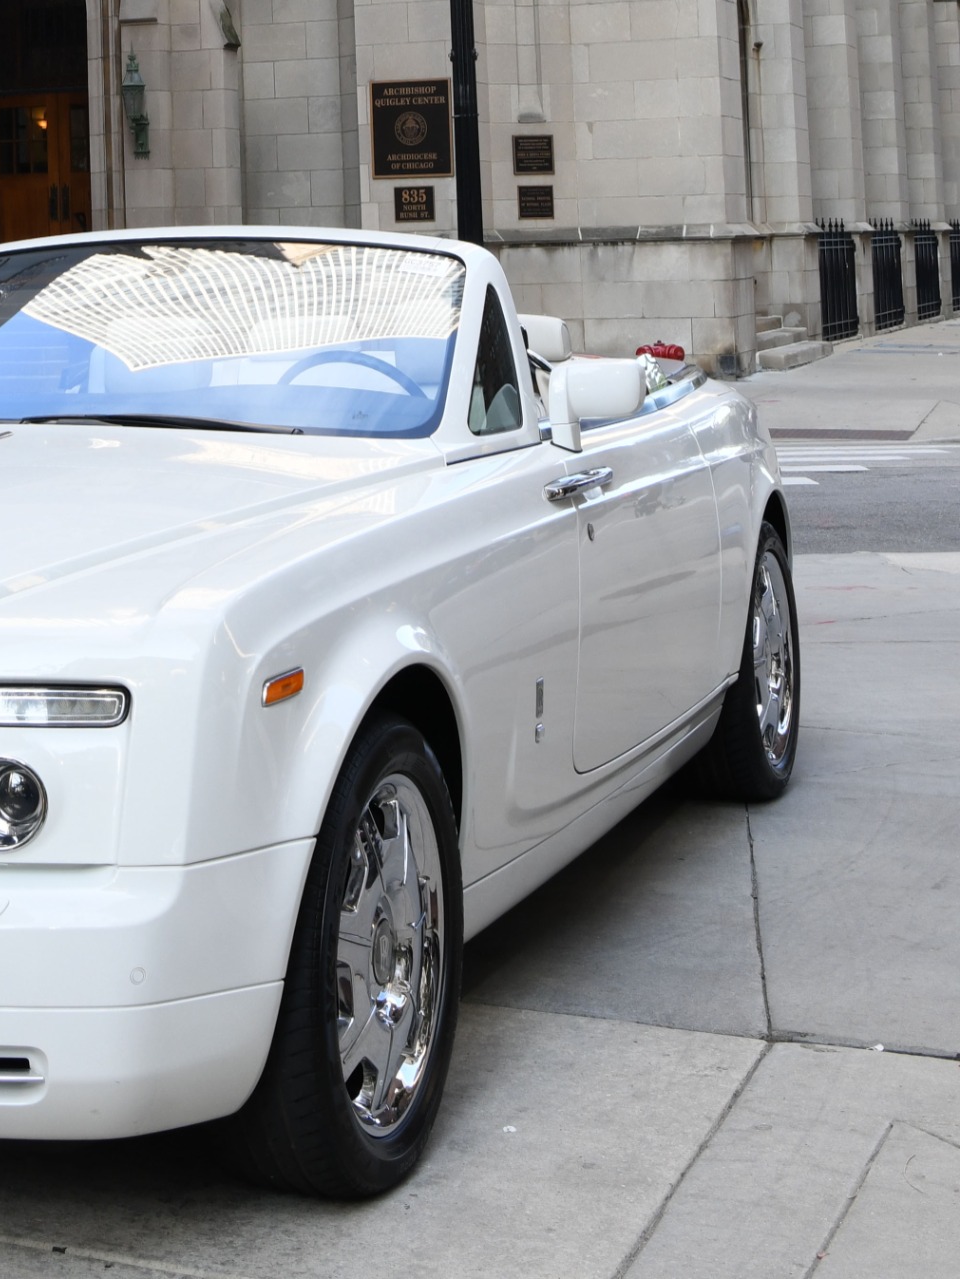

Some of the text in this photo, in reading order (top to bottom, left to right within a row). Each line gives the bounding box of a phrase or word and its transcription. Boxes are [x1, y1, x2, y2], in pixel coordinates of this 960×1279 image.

[383, 86, 437, 96] ARCHBISHOP
[375, 96, 446, 108] QUIGLEY CENTER
[386, 152, 438, 162] ARCHDIOCESE
[391, 161, 434, 171] OF CHICAGO
[401, 189, 427, 203] 835
[403, 203, 426, 212] NORTH
[400, 211, 418, 219] RUSH
